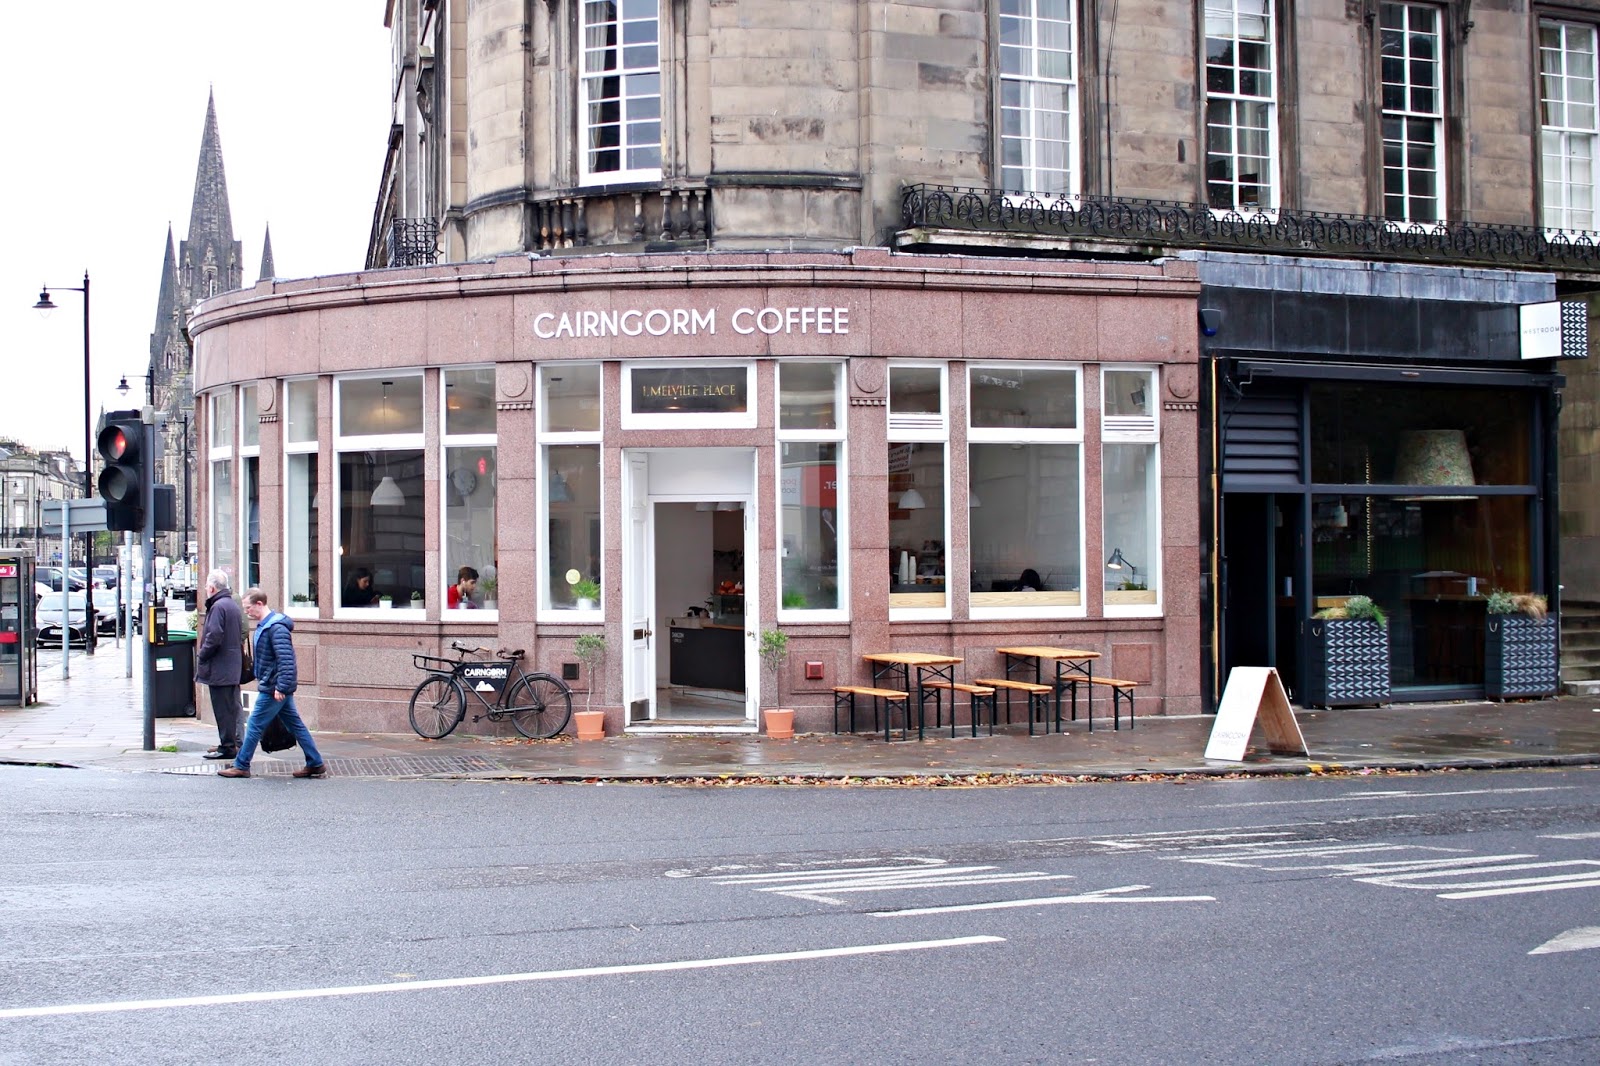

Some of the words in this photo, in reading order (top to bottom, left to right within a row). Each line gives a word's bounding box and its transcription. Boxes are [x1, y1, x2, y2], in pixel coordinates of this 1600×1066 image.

[533, 308, 716, 338] CAIRNGORM
[731, 307, 849, 335] COFFEE
[1523, 326, 1560, 334] WESTROOM
[703, 384, 736, 396] PLACE
[464, 668, 507, 676] CAIRNGORM
